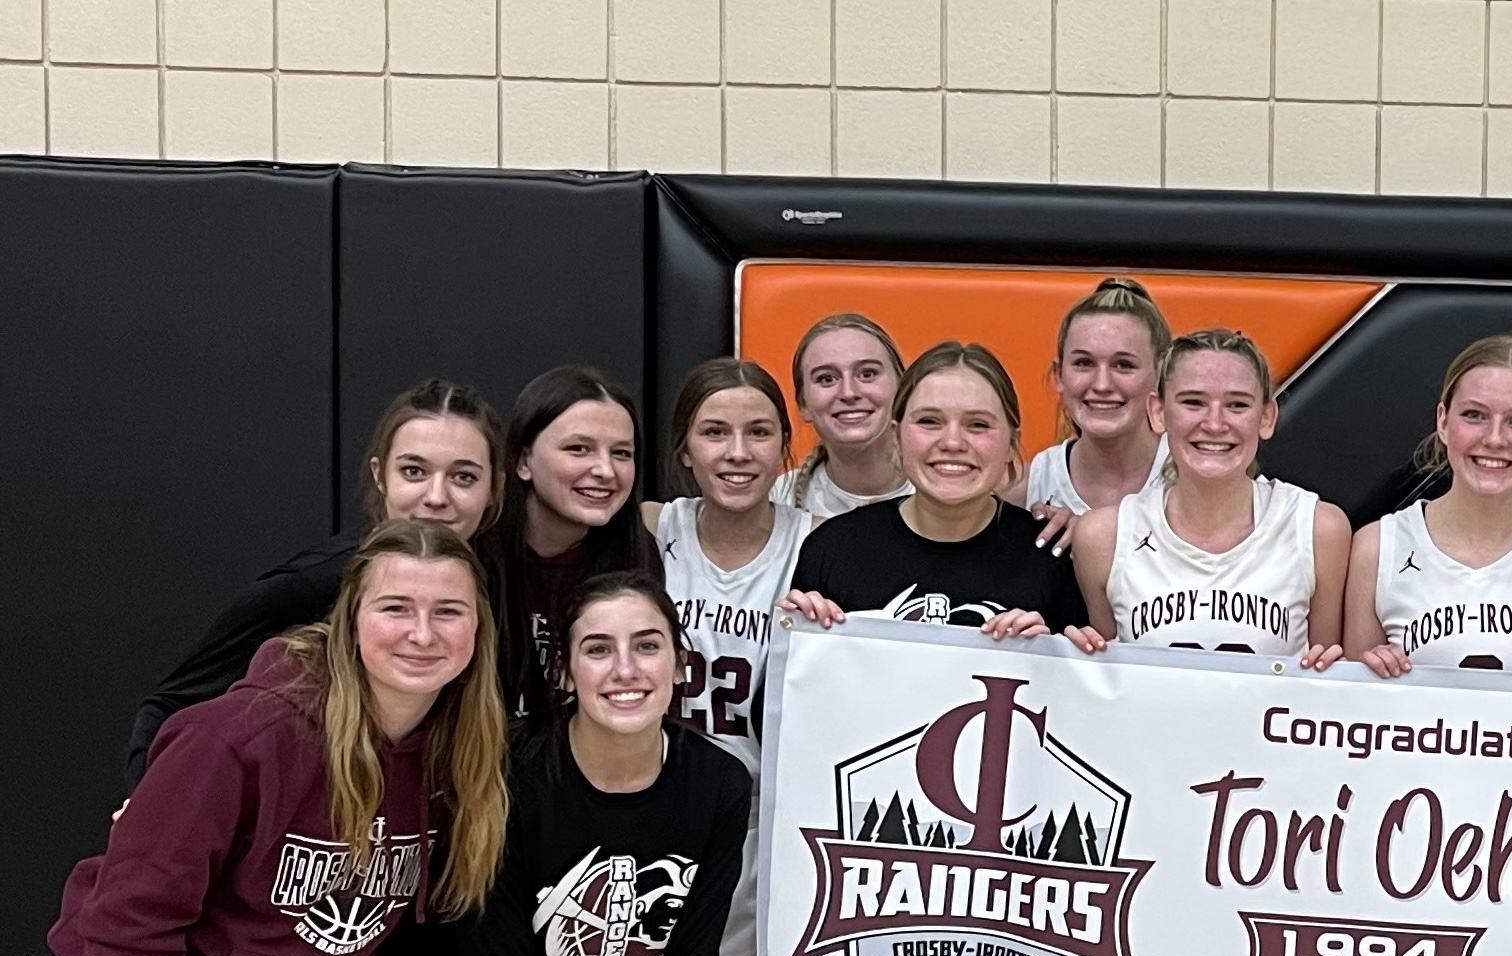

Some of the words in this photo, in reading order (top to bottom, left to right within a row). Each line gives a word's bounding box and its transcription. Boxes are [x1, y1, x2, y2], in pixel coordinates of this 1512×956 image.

[1131, 589, 1290, 643] CROSBY-IRONTON
[1189, 769, 1353, 893] Tori
[839, 857, 1110, 945] RANGERS
